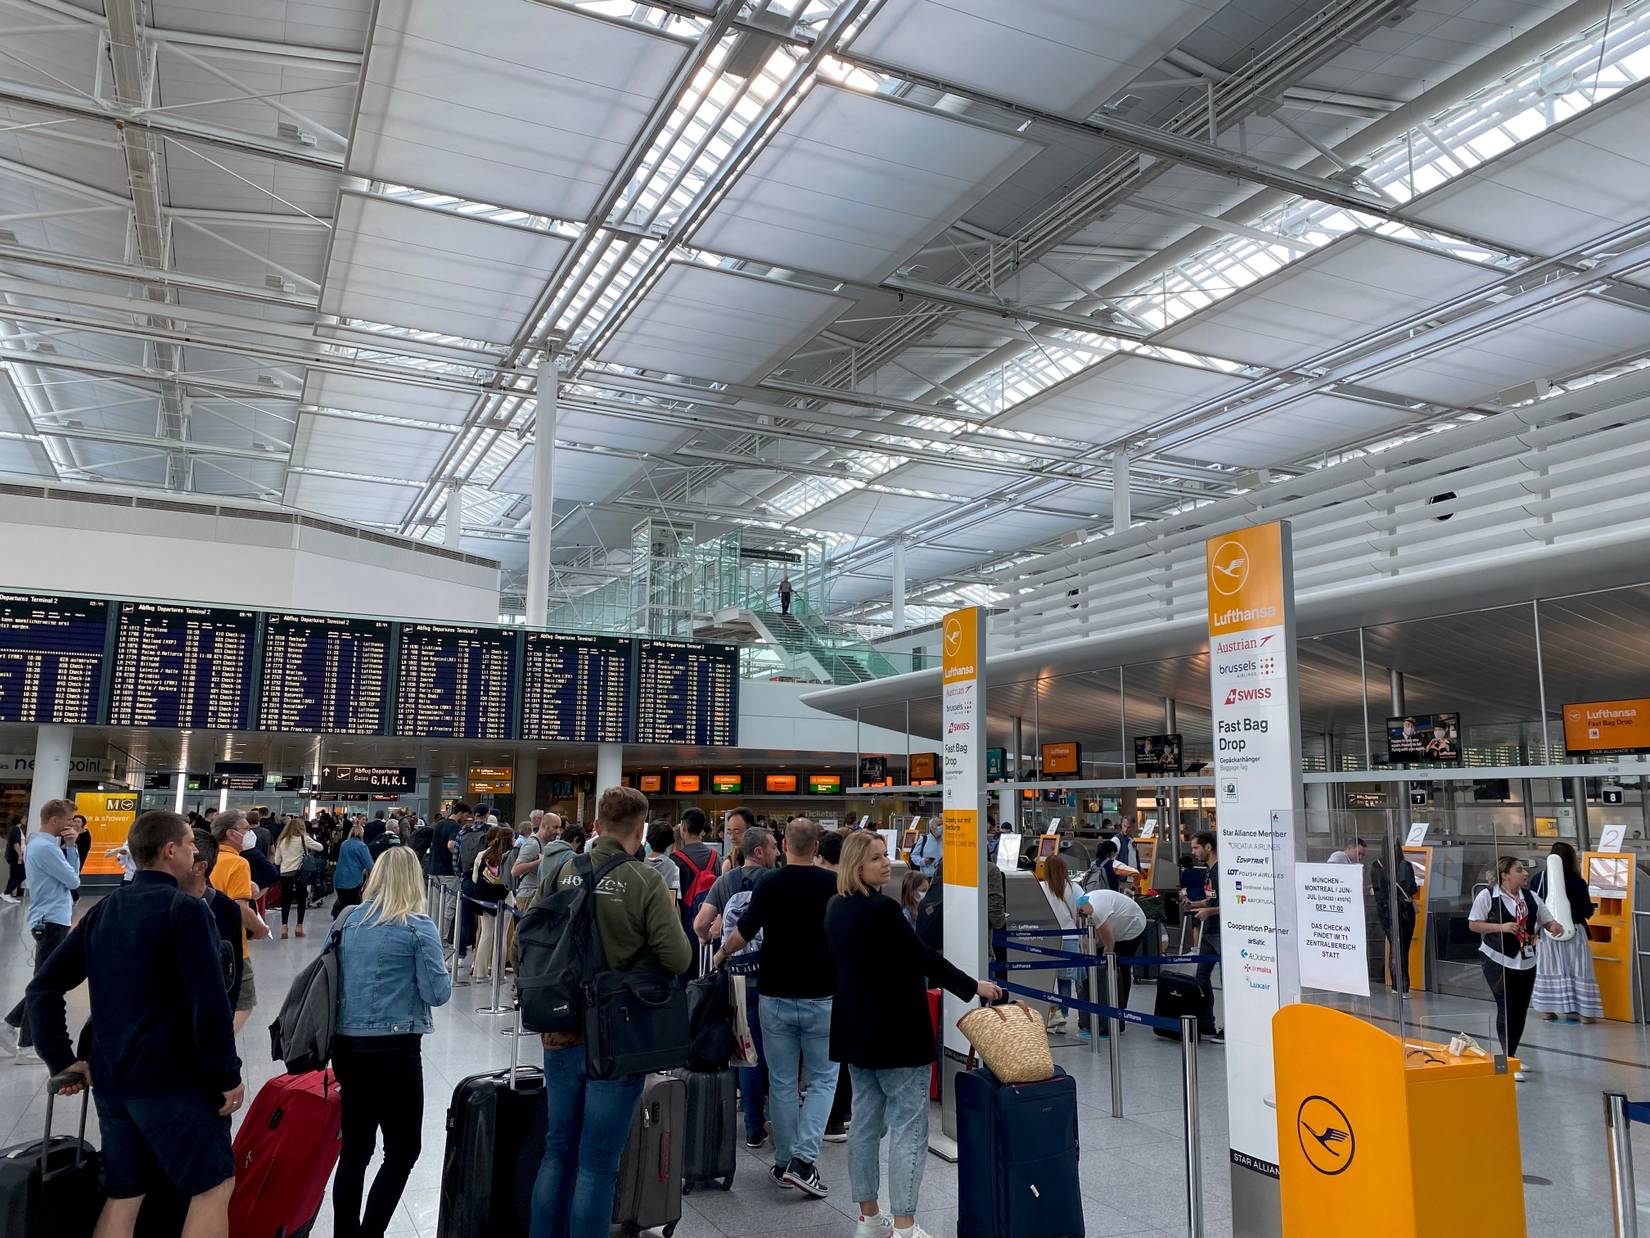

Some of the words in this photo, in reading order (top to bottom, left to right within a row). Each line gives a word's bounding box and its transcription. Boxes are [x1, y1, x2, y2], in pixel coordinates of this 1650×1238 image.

[1214, 606, 1276, 627] Lufthansa
[1216, 638, 1257, 655] Austrian
[945, 665, 974, 678] Lufthansa
[1219, 661, 1256, 675] brussels
[1238, 688, 1271, 701] SWISS
[1587, 709, 1636, 719] Lufthansa
[954, 722, 970, 731] SWISS
[1218, 720, 1241, 733] Fast
[1244, 718, 1268, 733] Bag
[945, 744, 955, 753] Fast
[956, 743, 968, 754] Bag
[1219, 738, 1246, 752] Drop
[945, 757, 957, 767] Drop
[355, 767, 371, 775] Abflug
[402, 777, 407, 785] L
[1610, 793, 1616, 802] 8
[107, 800, 118, 810] M
[1235, 829, 1257, 837] Alliance
[1258, 830, 1287, 838] Member
[1410, 827, 1423, 842] 2
[1604, 830, 1618, 847] 2
[1305, 885, 1334, 893] MONTREAL
[1228, 922, 1263, 932] Cooperation
[1264, 926, 1289, 935] Parner
[1324, 924, 1350, 932] CHECK-IN
[1306, 940, 1356, 950] ZENTRALBEREICH
[1322, 951, 1339, 959] STATT
[1123, 1012, 1141, 1021] Lufthansa
[1233, 1153, 1252, 1166] STAR
[1253, 1160, 1280, 1176] ALLIAN
